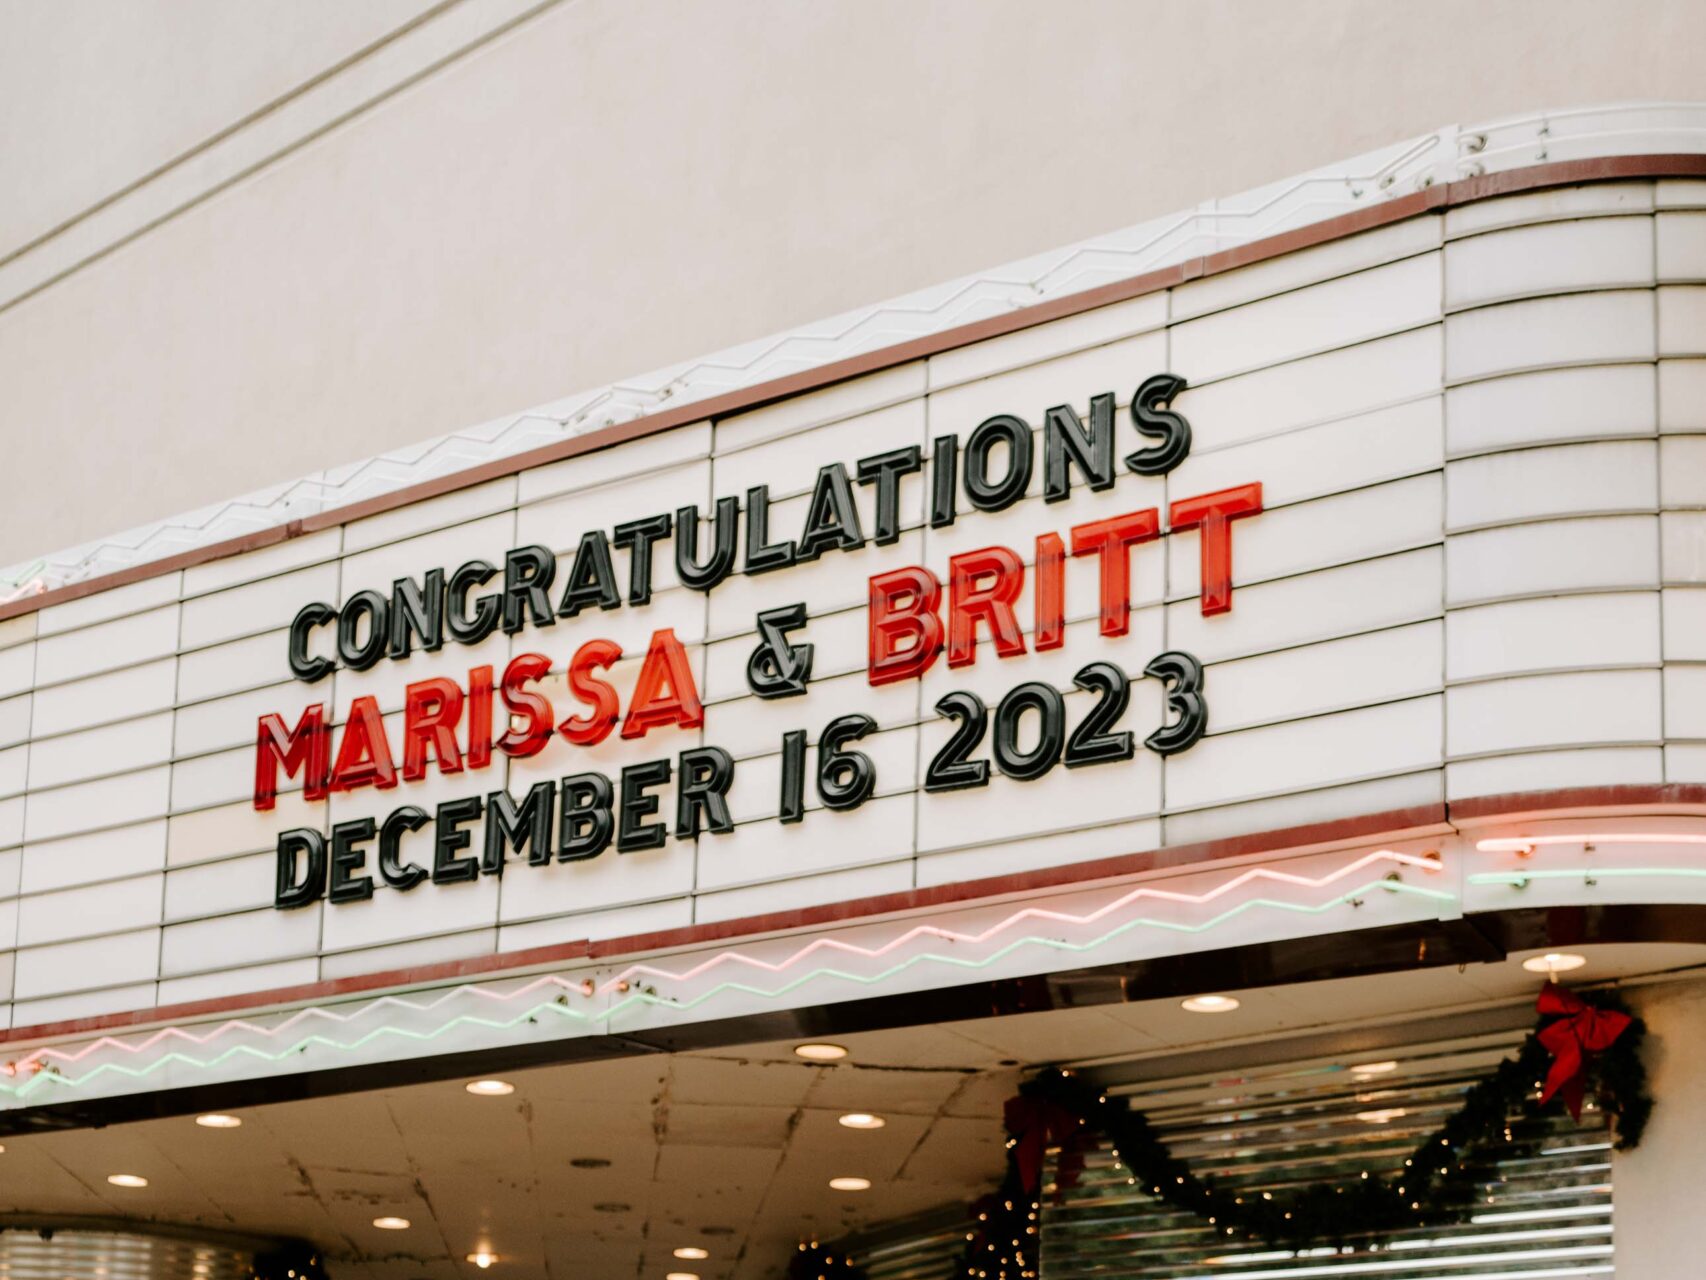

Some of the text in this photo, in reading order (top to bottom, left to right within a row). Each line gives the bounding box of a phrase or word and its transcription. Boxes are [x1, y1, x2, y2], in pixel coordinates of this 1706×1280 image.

[253, 481, 1262, 811] MARISSA & BRITT
[289, 373, 1192, 683] CONGRATULATIONS
[275, 651, 1208, 910] DECEMBER 16 2023
